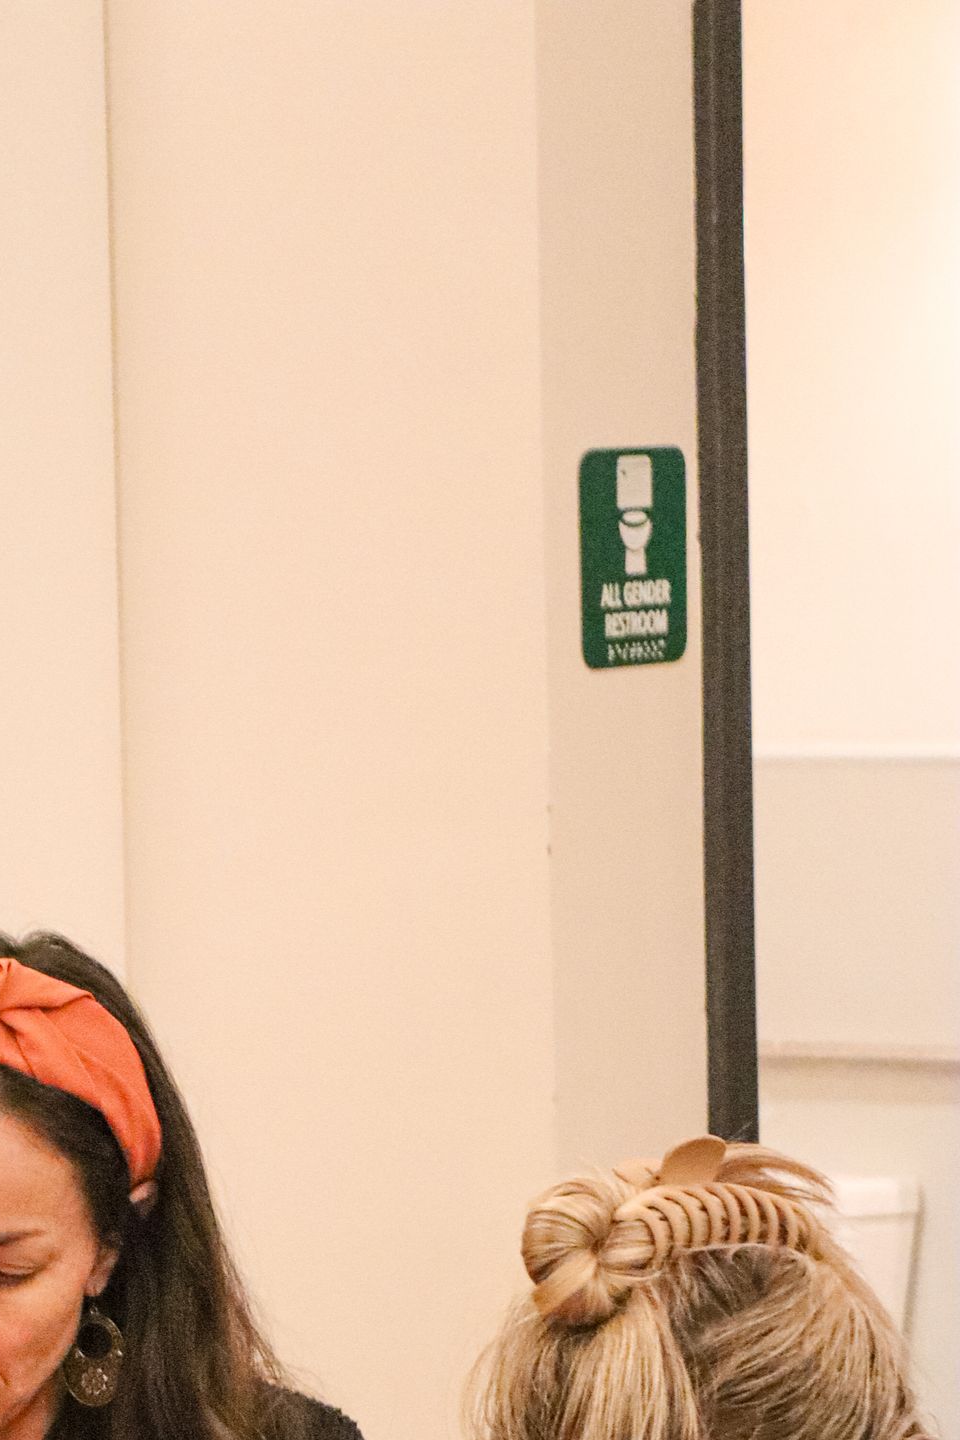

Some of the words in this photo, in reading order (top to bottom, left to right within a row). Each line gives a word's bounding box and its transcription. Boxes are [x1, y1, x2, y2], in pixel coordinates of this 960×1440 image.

[600, 582, 623, 609] ALL
[623, 578, 672, 607] GENDER
[604, 609, 669, 638] RESTROOM
